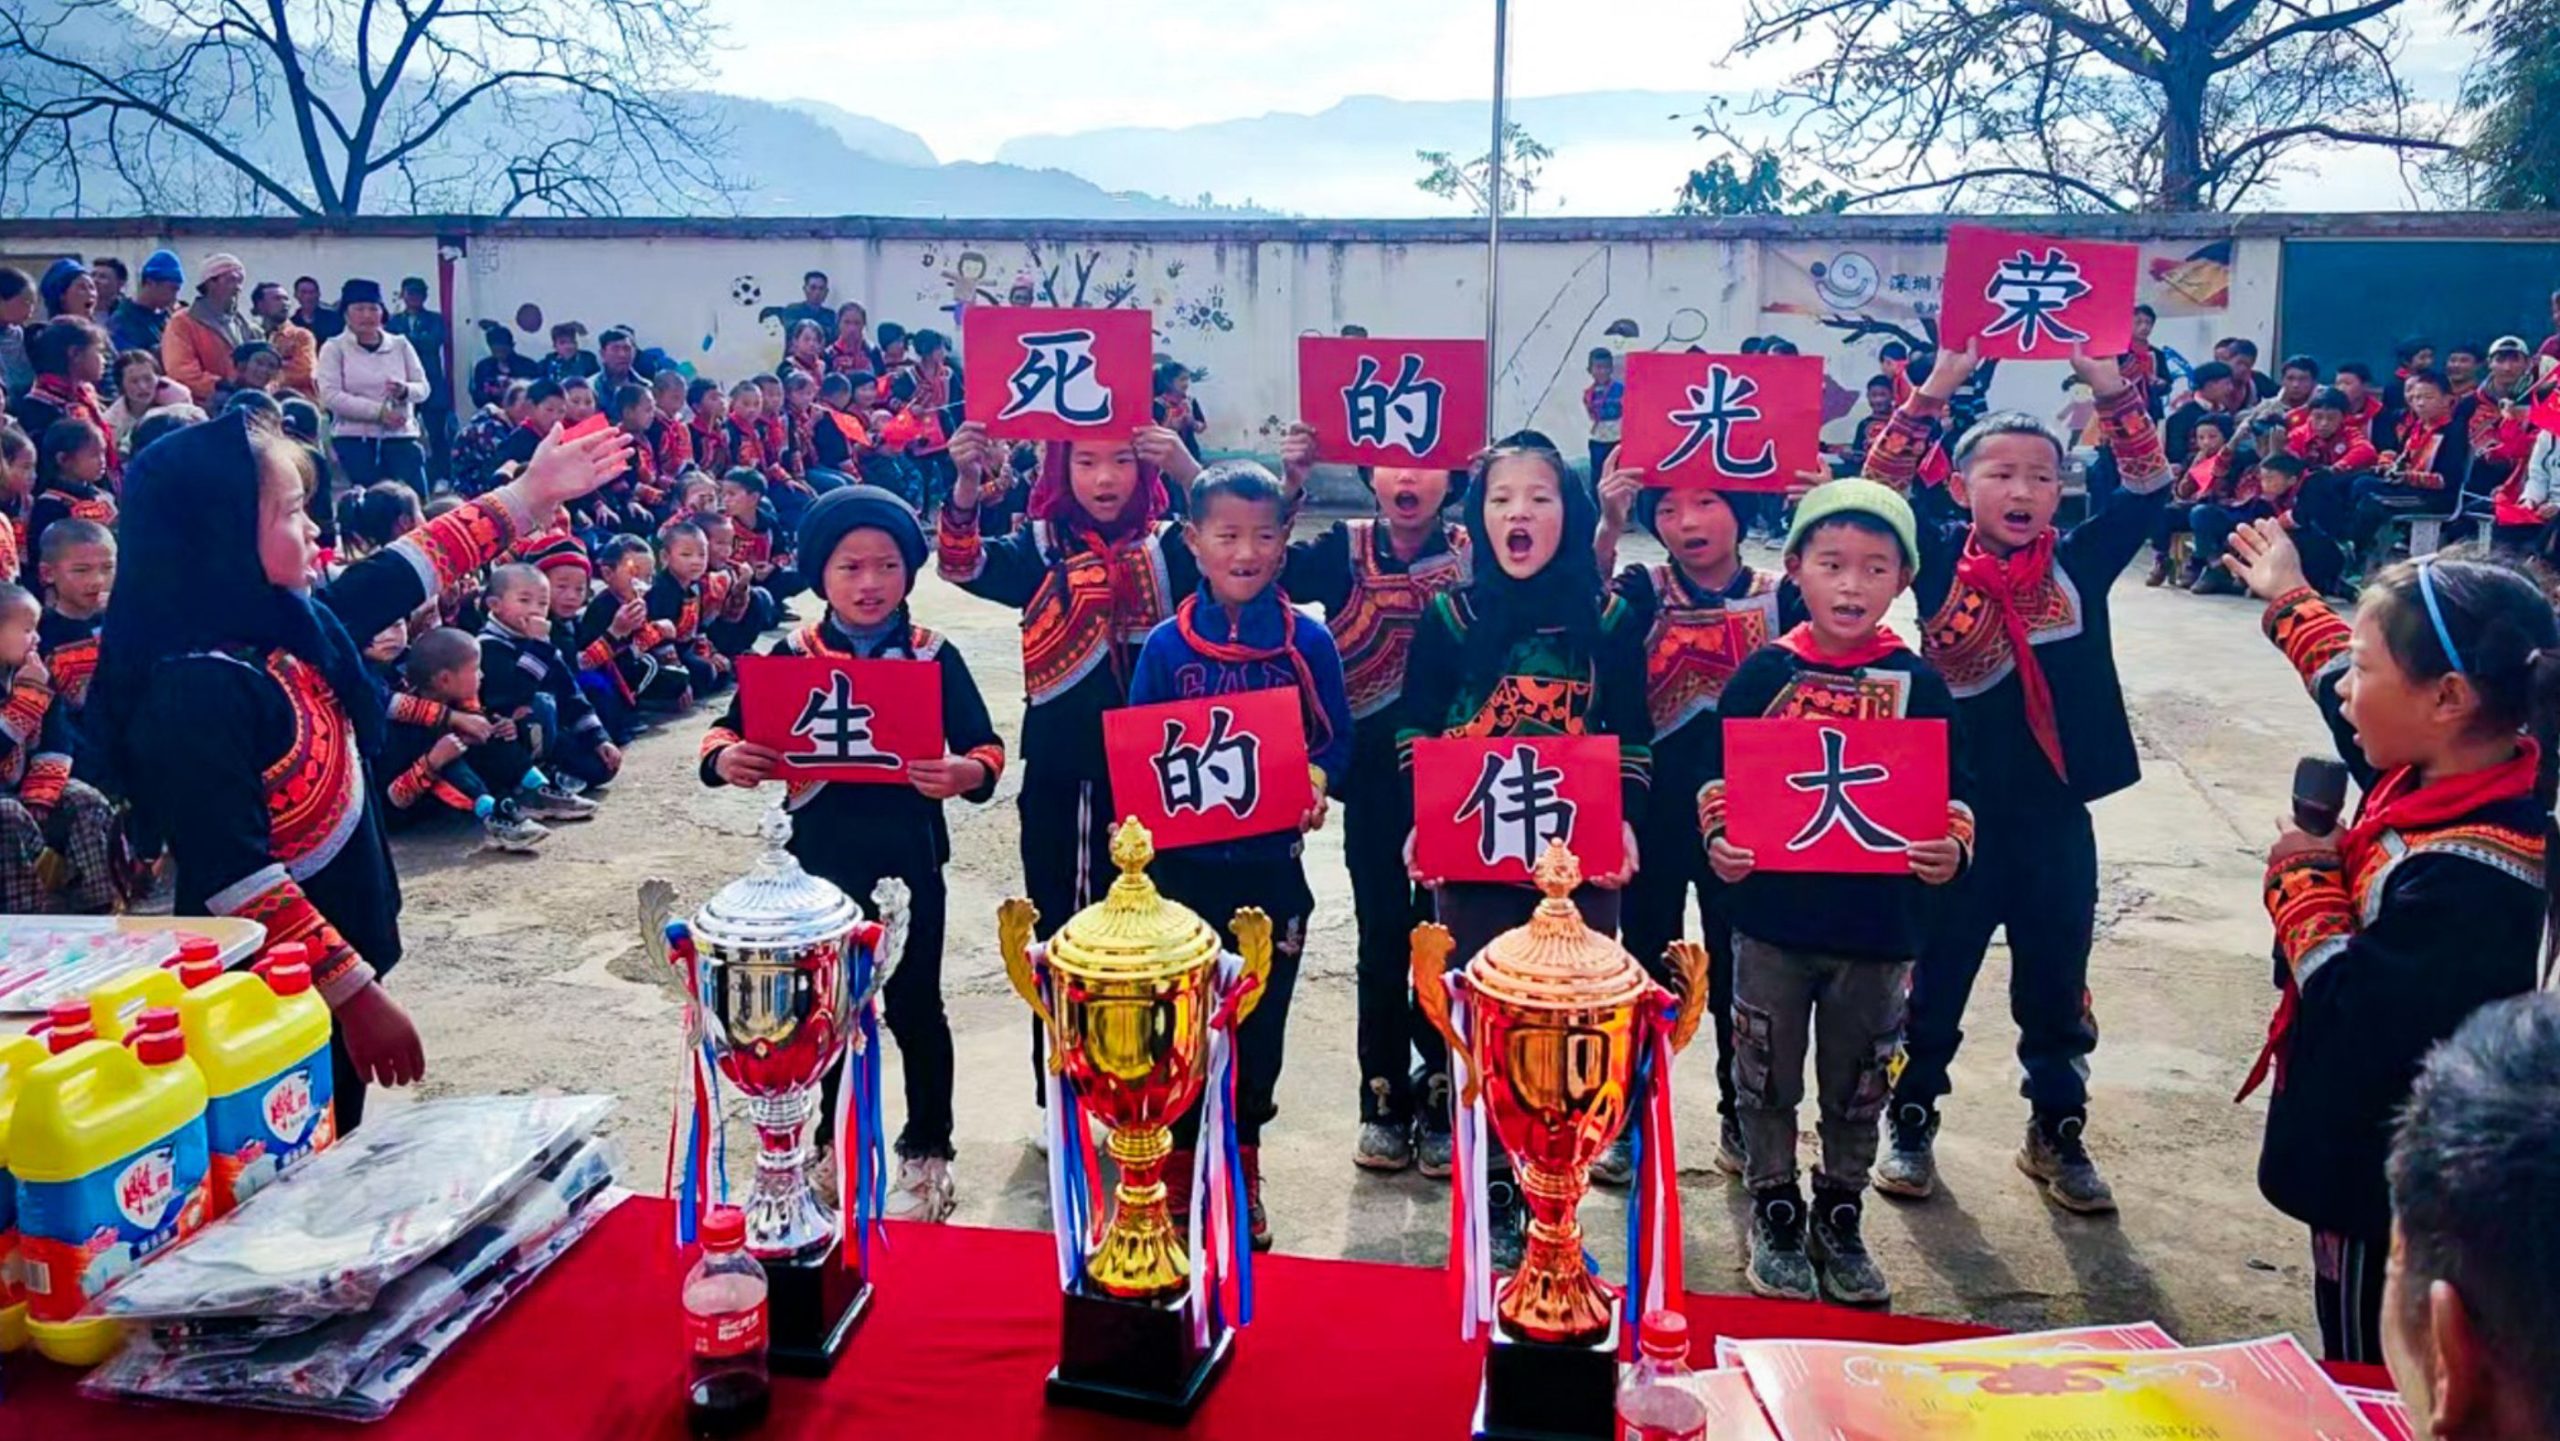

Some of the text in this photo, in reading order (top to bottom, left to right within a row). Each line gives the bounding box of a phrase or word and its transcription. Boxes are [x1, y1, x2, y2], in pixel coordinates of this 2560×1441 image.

[1984, 248, 2090, 351] 荣
[1000, 328, 1113, 426] 死
[1341, 353, 1445, 458] 的
[1658, 364, 1776, 478] 光
[784, 671, 902, 770] 生
[1152, 707, 1259, 817] 的
[1456, 745, 1575, 867] 伟
[1787, 728, 1909, 854] 大
